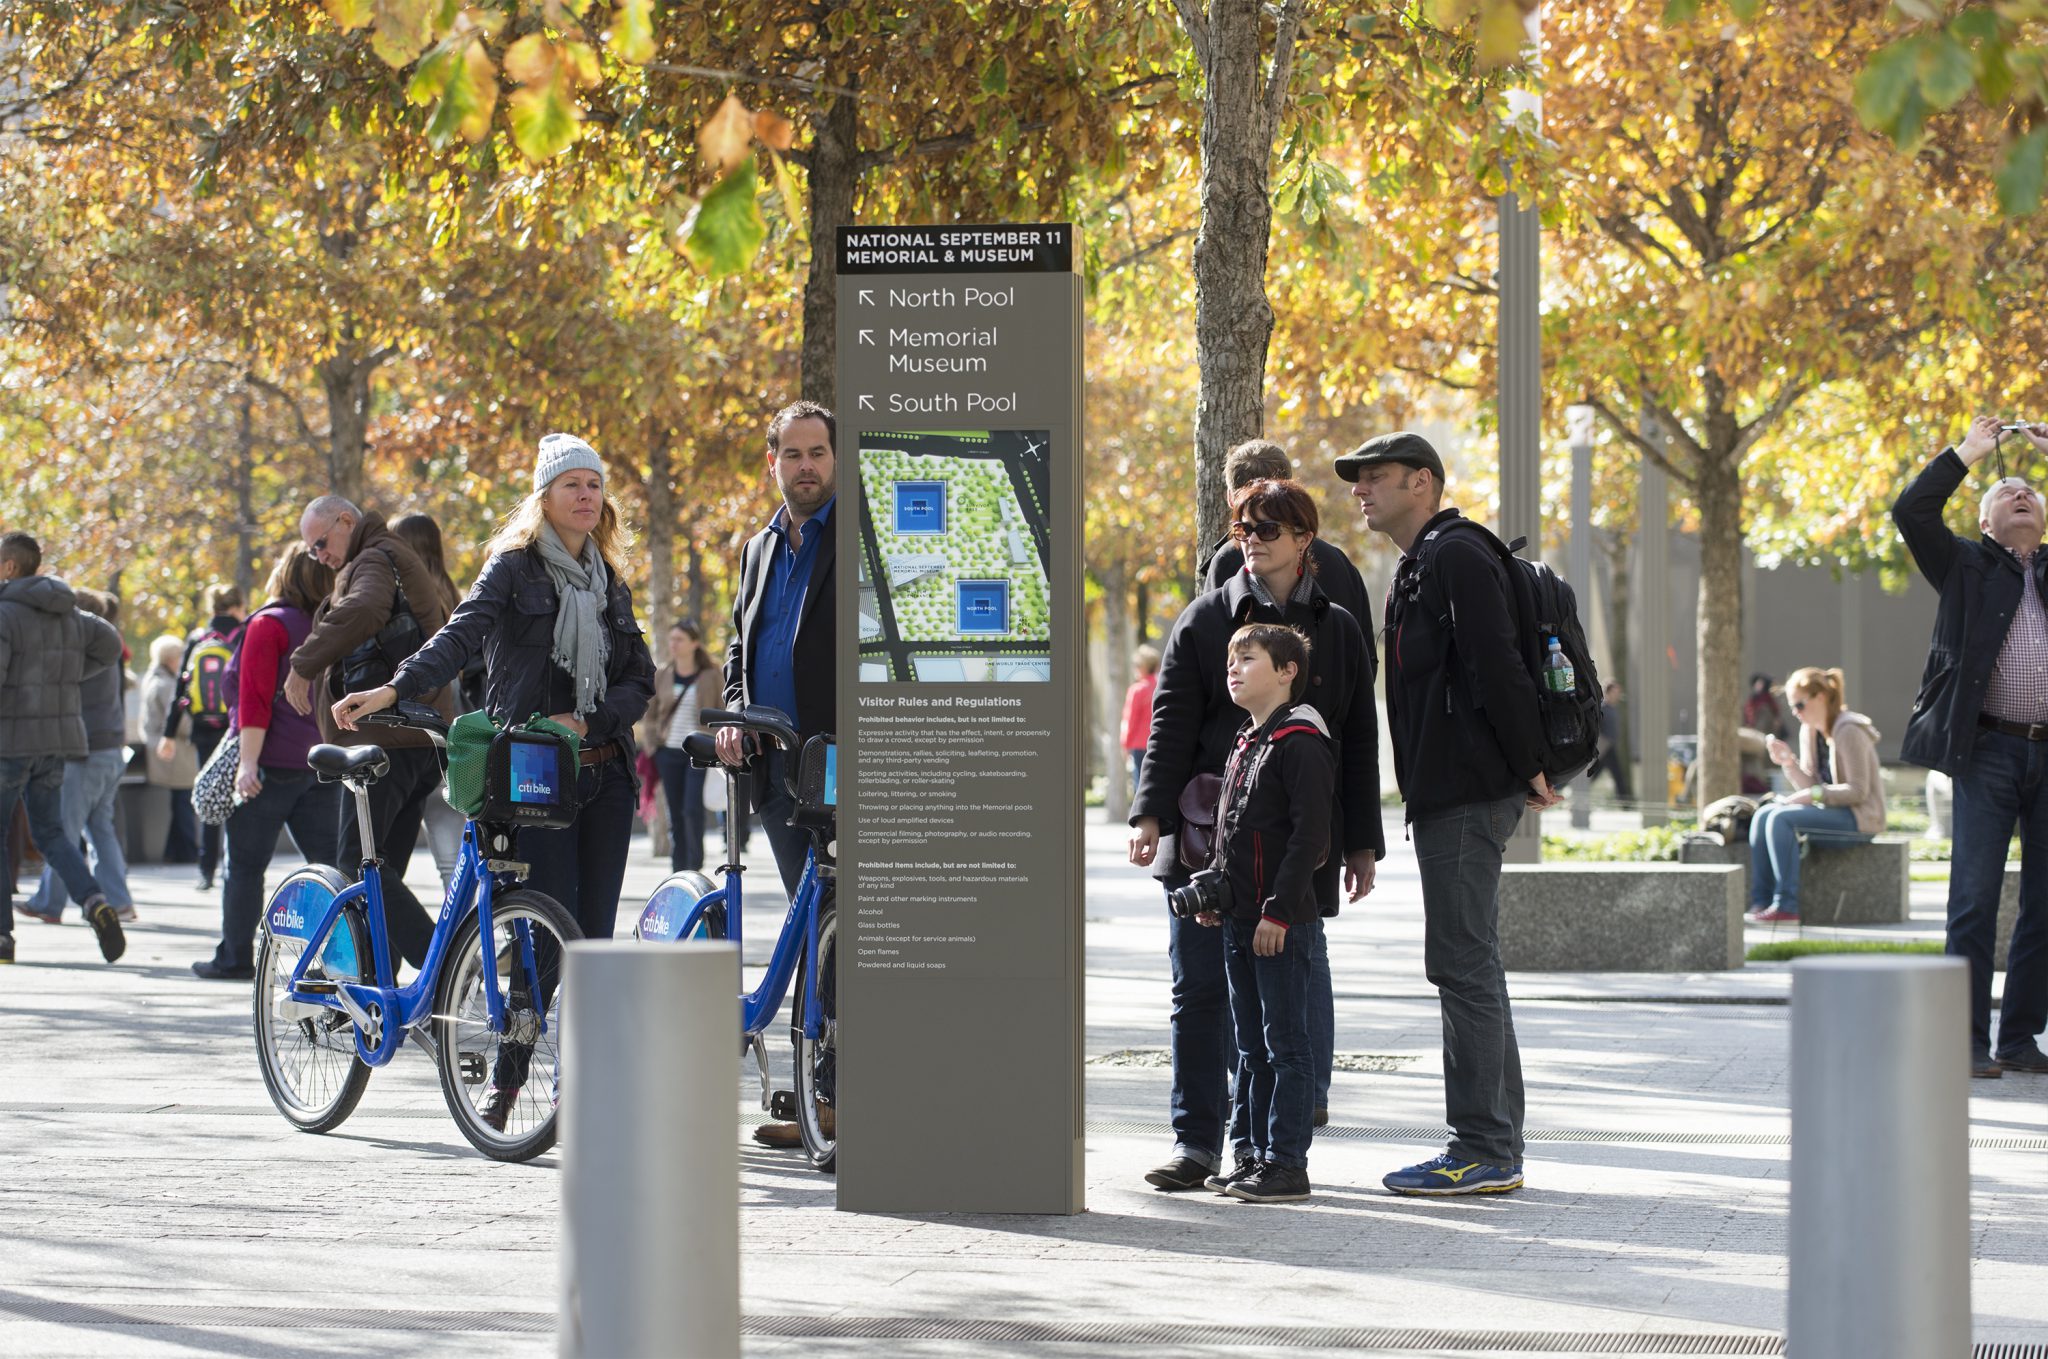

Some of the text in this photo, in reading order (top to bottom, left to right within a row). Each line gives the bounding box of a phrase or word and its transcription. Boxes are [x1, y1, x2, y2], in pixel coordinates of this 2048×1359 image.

[847, 231, 1061, 248] NATIONAL SEPTEMBER 11
[847, 248, 1034, 264] MEMORIAL & MUSEUM
[890, 287, 1014, 308] North Pool
[890, 326, 997, 347] Memorial
[890, 354, 987, 373] Museum
[889, 392, 1016, 413] South Pool
[858, 696, 1022, 708] Visitor Rules and Regulations
[858, 729, 894, 737] Expressive
[938, 736, 947, 744] by
[886, 757, 922, 765] third-party
[923, 757, 950, 765] vending
[858, 770, 887, 778] Sporting
[920, 770, 951, 778] including
[928, 790, 957, 798] smoking
[858, 803, 890, 812] Throwing
[899, 804, 924, 812] placing
[925, 804, 954, 812] anything
[881, 837, 891, 845] by
[910, 895, 937, 903] marking
[938, 895, 978, 903] instruments
[948, 935, 976, 943] animals)
[857, 948, 876, 956] Open
[858, 961, 891, 969] Powdered
